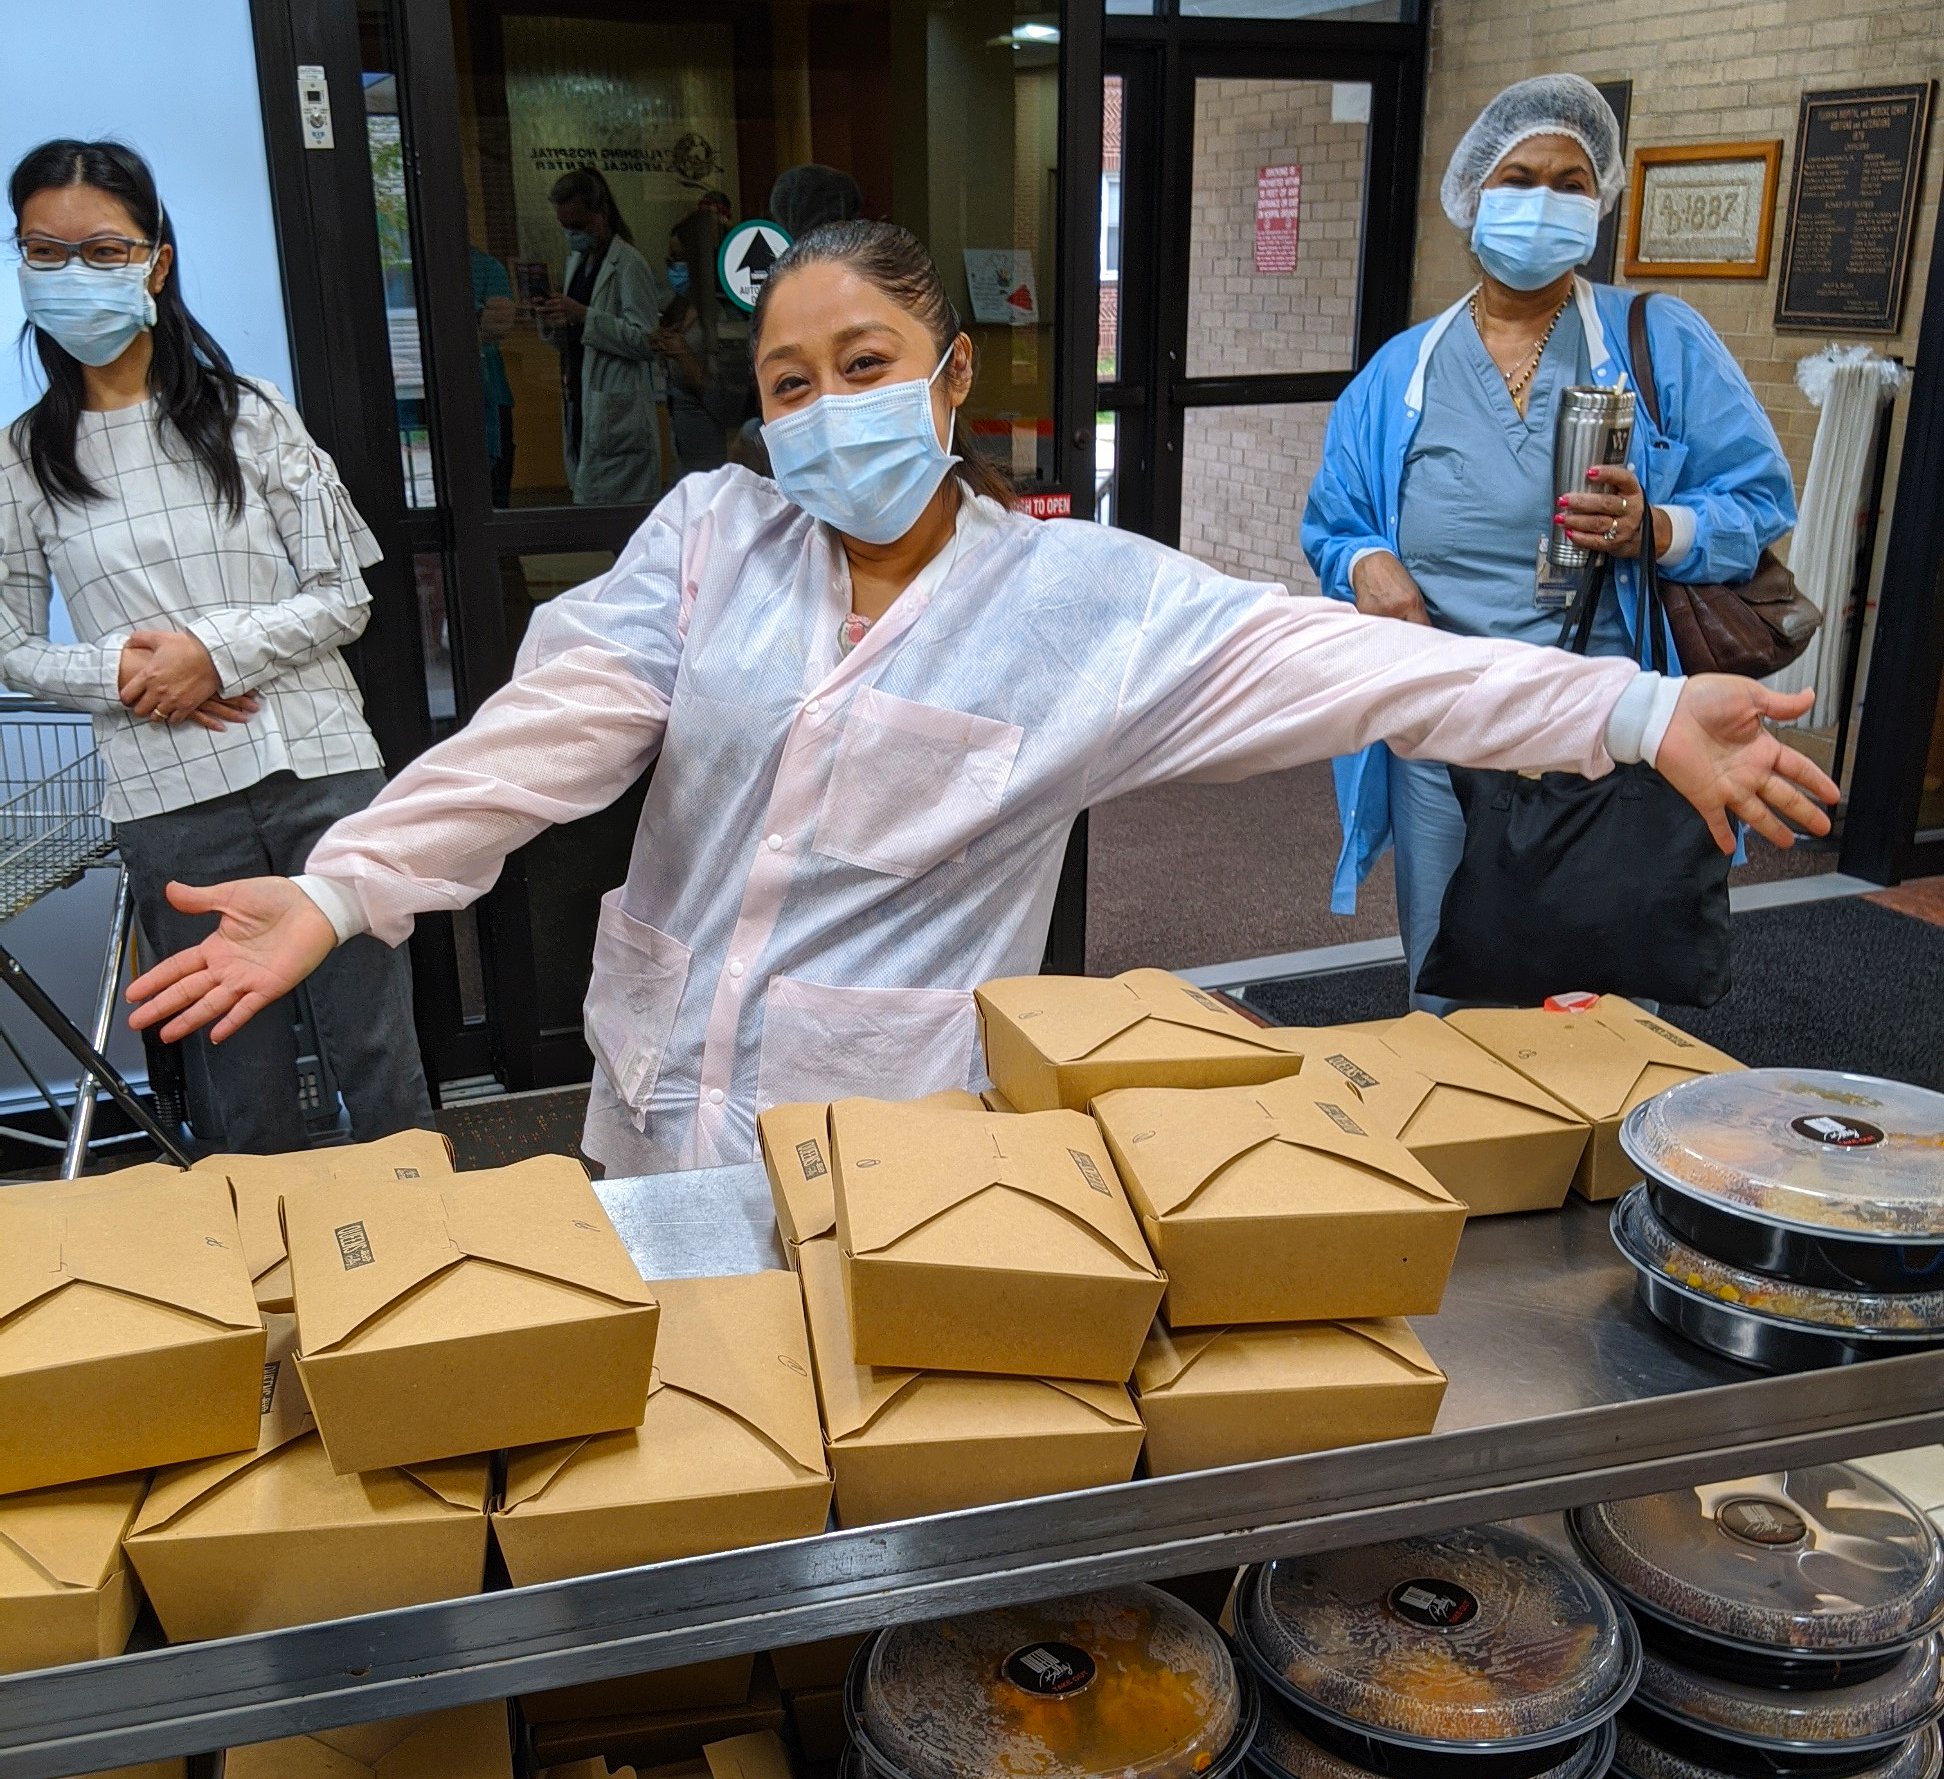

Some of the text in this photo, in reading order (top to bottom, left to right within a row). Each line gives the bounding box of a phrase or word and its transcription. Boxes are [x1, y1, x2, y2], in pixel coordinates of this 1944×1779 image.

[740, 286, 760, 295] AUTO
[1032, 497, 1045, 515] TO
[1046, 497, 1071, 515] OPEN
[336, 1224, 368, 1254] QUEENS
